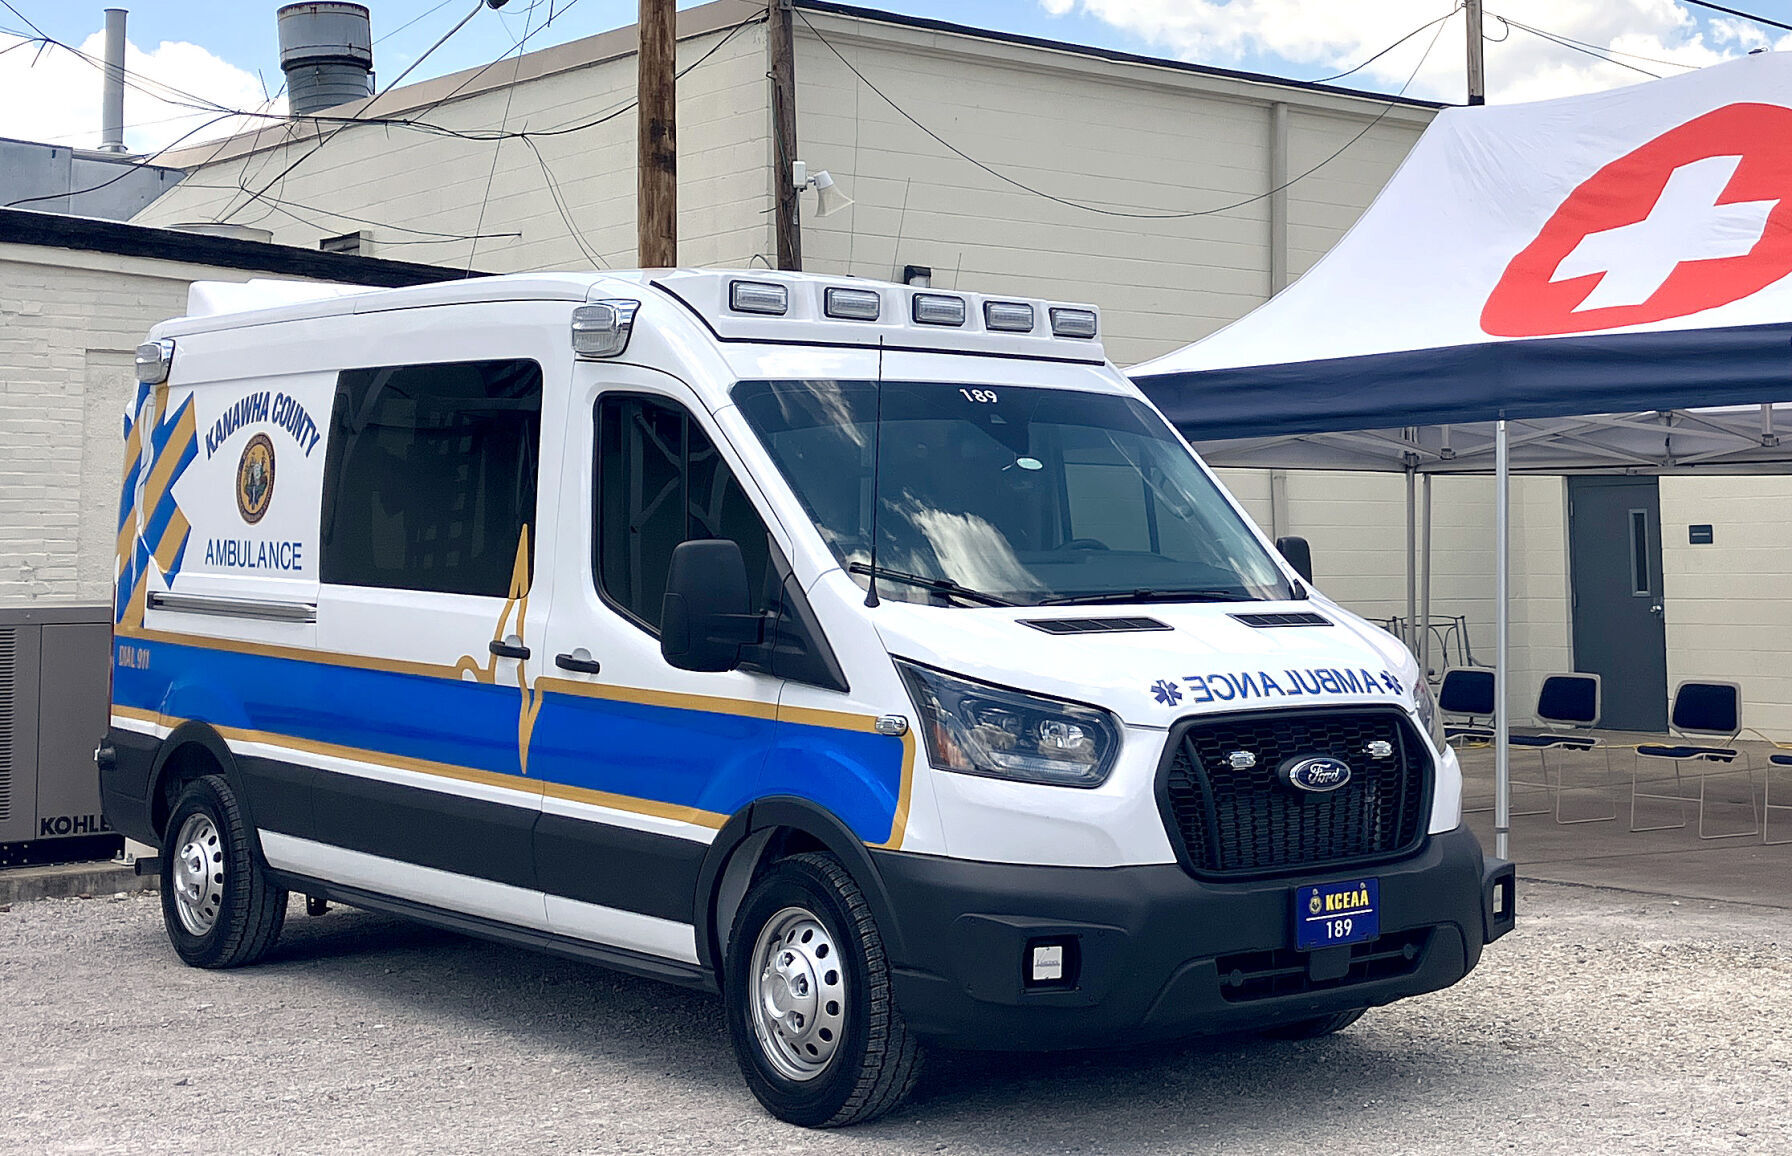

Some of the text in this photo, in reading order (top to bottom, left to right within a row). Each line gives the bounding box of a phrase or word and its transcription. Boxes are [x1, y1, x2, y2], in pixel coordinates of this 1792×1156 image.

[958, 388, 998, 403] 189
[205, 391, 321, 460] KANAWHA COUNTY
[205, 539, 302, 570] AMBULANCE
[119, 645, 150, 670] DIAL 911
[1308, 763, 1341, 784] Ford
[1325, 889, 1369, 911] KCEAA
[1326, 918, 1352, 939] 189
